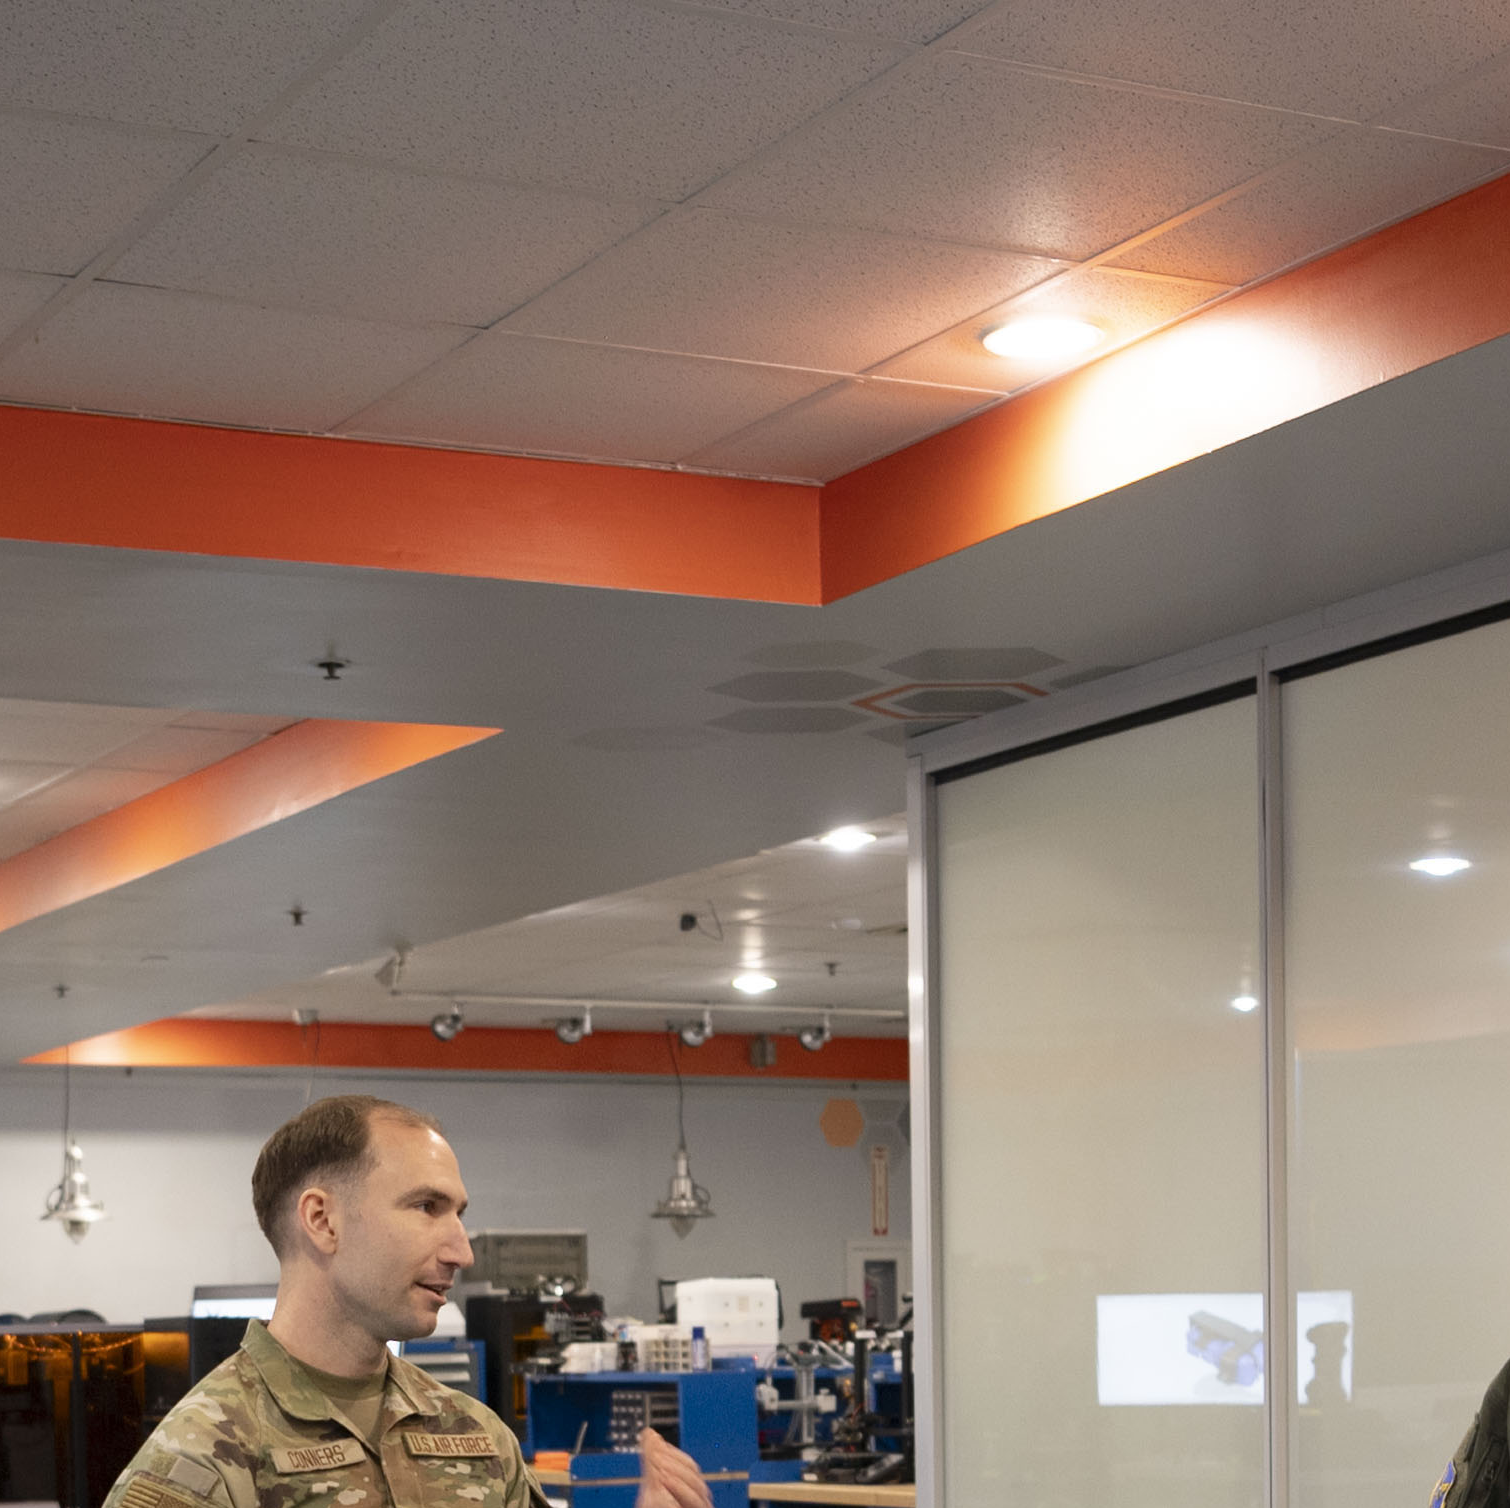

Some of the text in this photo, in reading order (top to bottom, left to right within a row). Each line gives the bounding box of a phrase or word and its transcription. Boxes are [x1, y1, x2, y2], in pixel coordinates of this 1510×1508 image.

[410, 1437, 494, 1454] U.S. AIR FORCE
[287, 1445, 346, 1469] CONNERS
